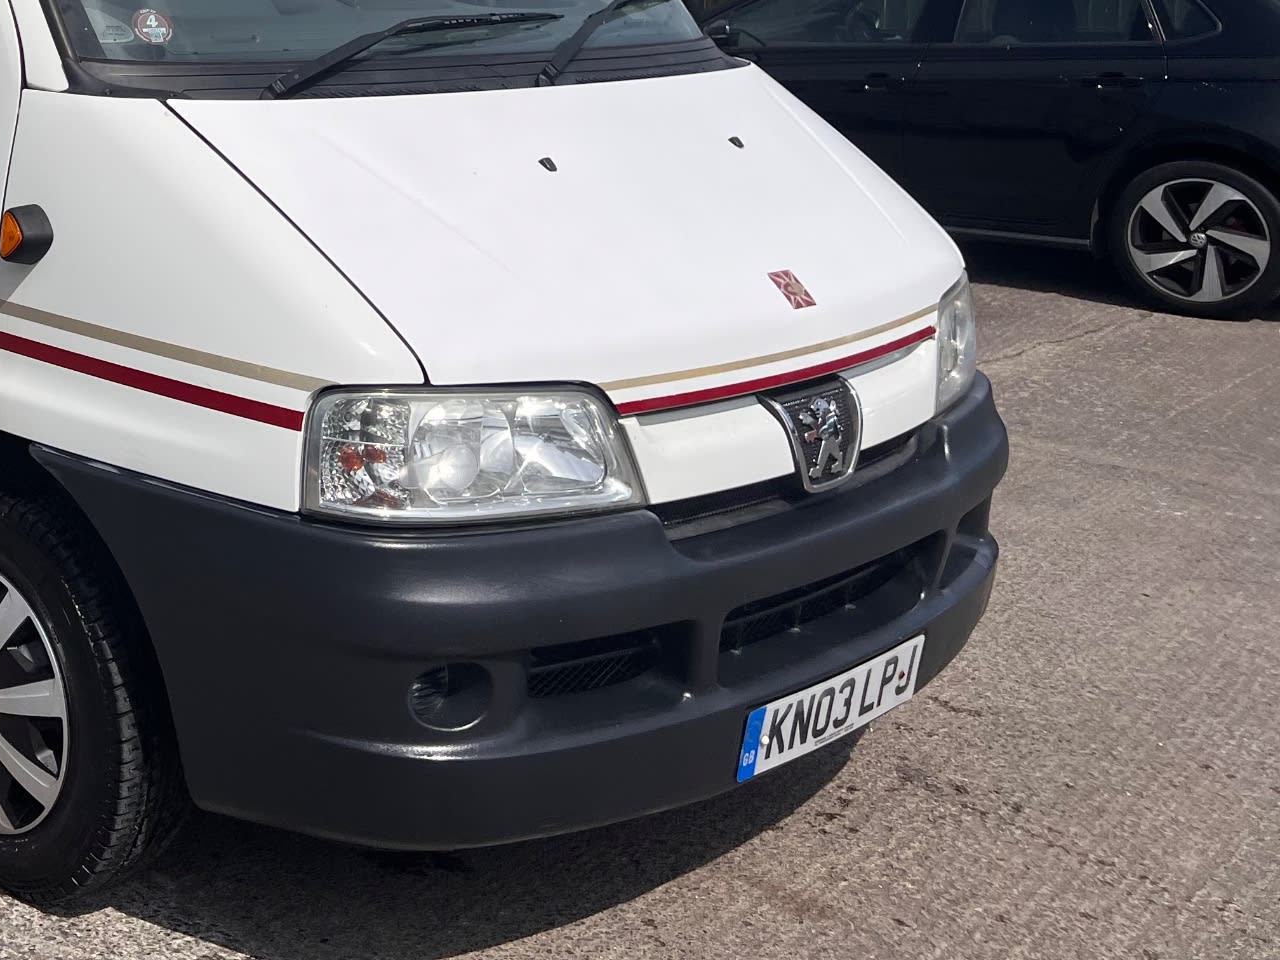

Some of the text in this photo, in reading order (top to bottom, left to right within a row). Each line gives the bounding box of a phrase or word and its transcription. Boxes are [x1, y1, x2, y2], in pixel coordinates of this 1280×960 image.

[764, 644, 918, 761] KN03 LPJ
[742, 749, 755, 767] GB
